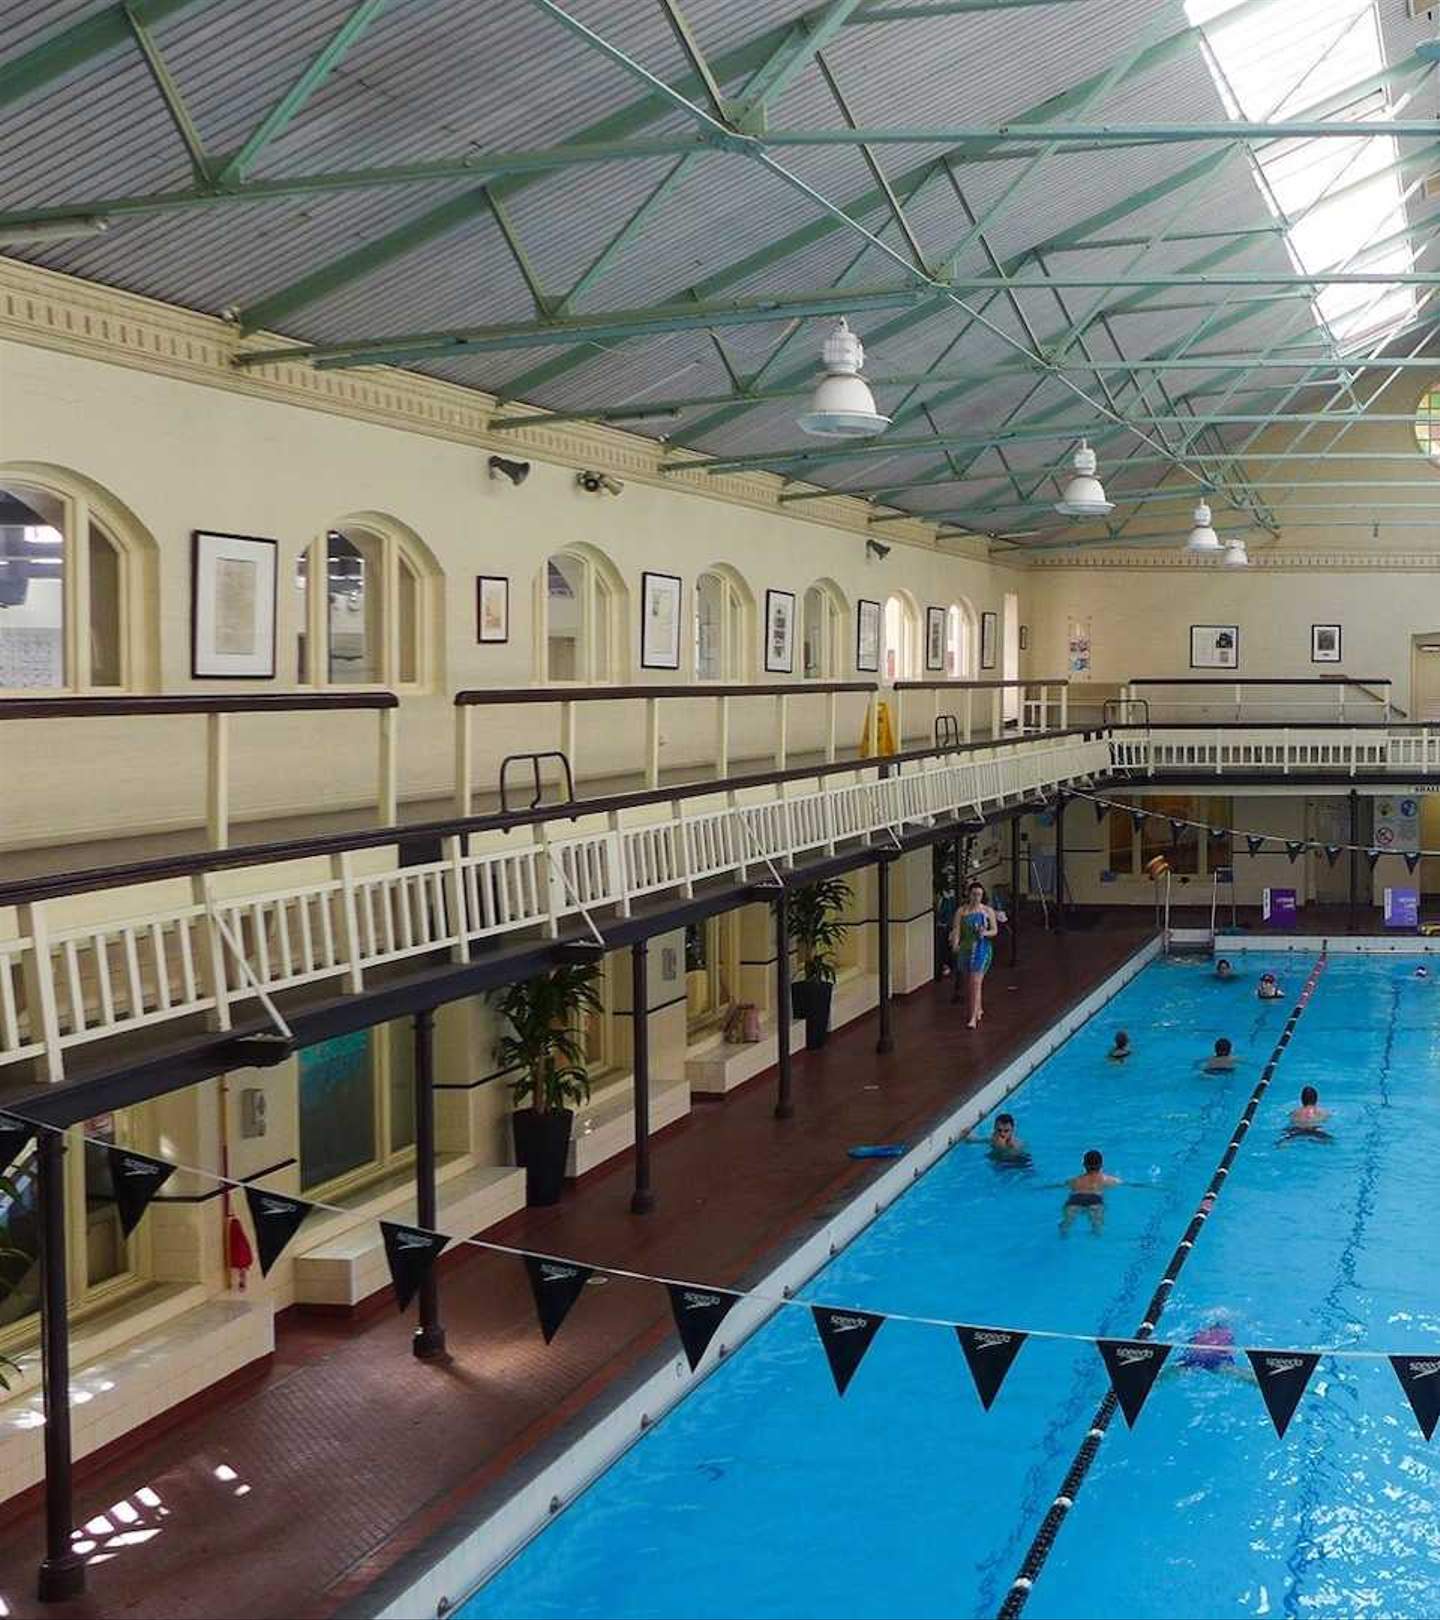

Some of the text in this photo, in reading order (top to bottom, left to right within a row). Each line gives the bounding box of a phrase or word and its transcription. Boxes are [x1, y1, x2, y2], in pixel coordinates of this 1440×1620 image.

[683, 1292, 721, 1305] speedo
[831, 1314, 867, 1328] speedo
[974, 1331, 1011, 1343] speedo
[1116, 1347, 1154, 1359] speedo
[1266, 1357, 1303, 1368] speedo
